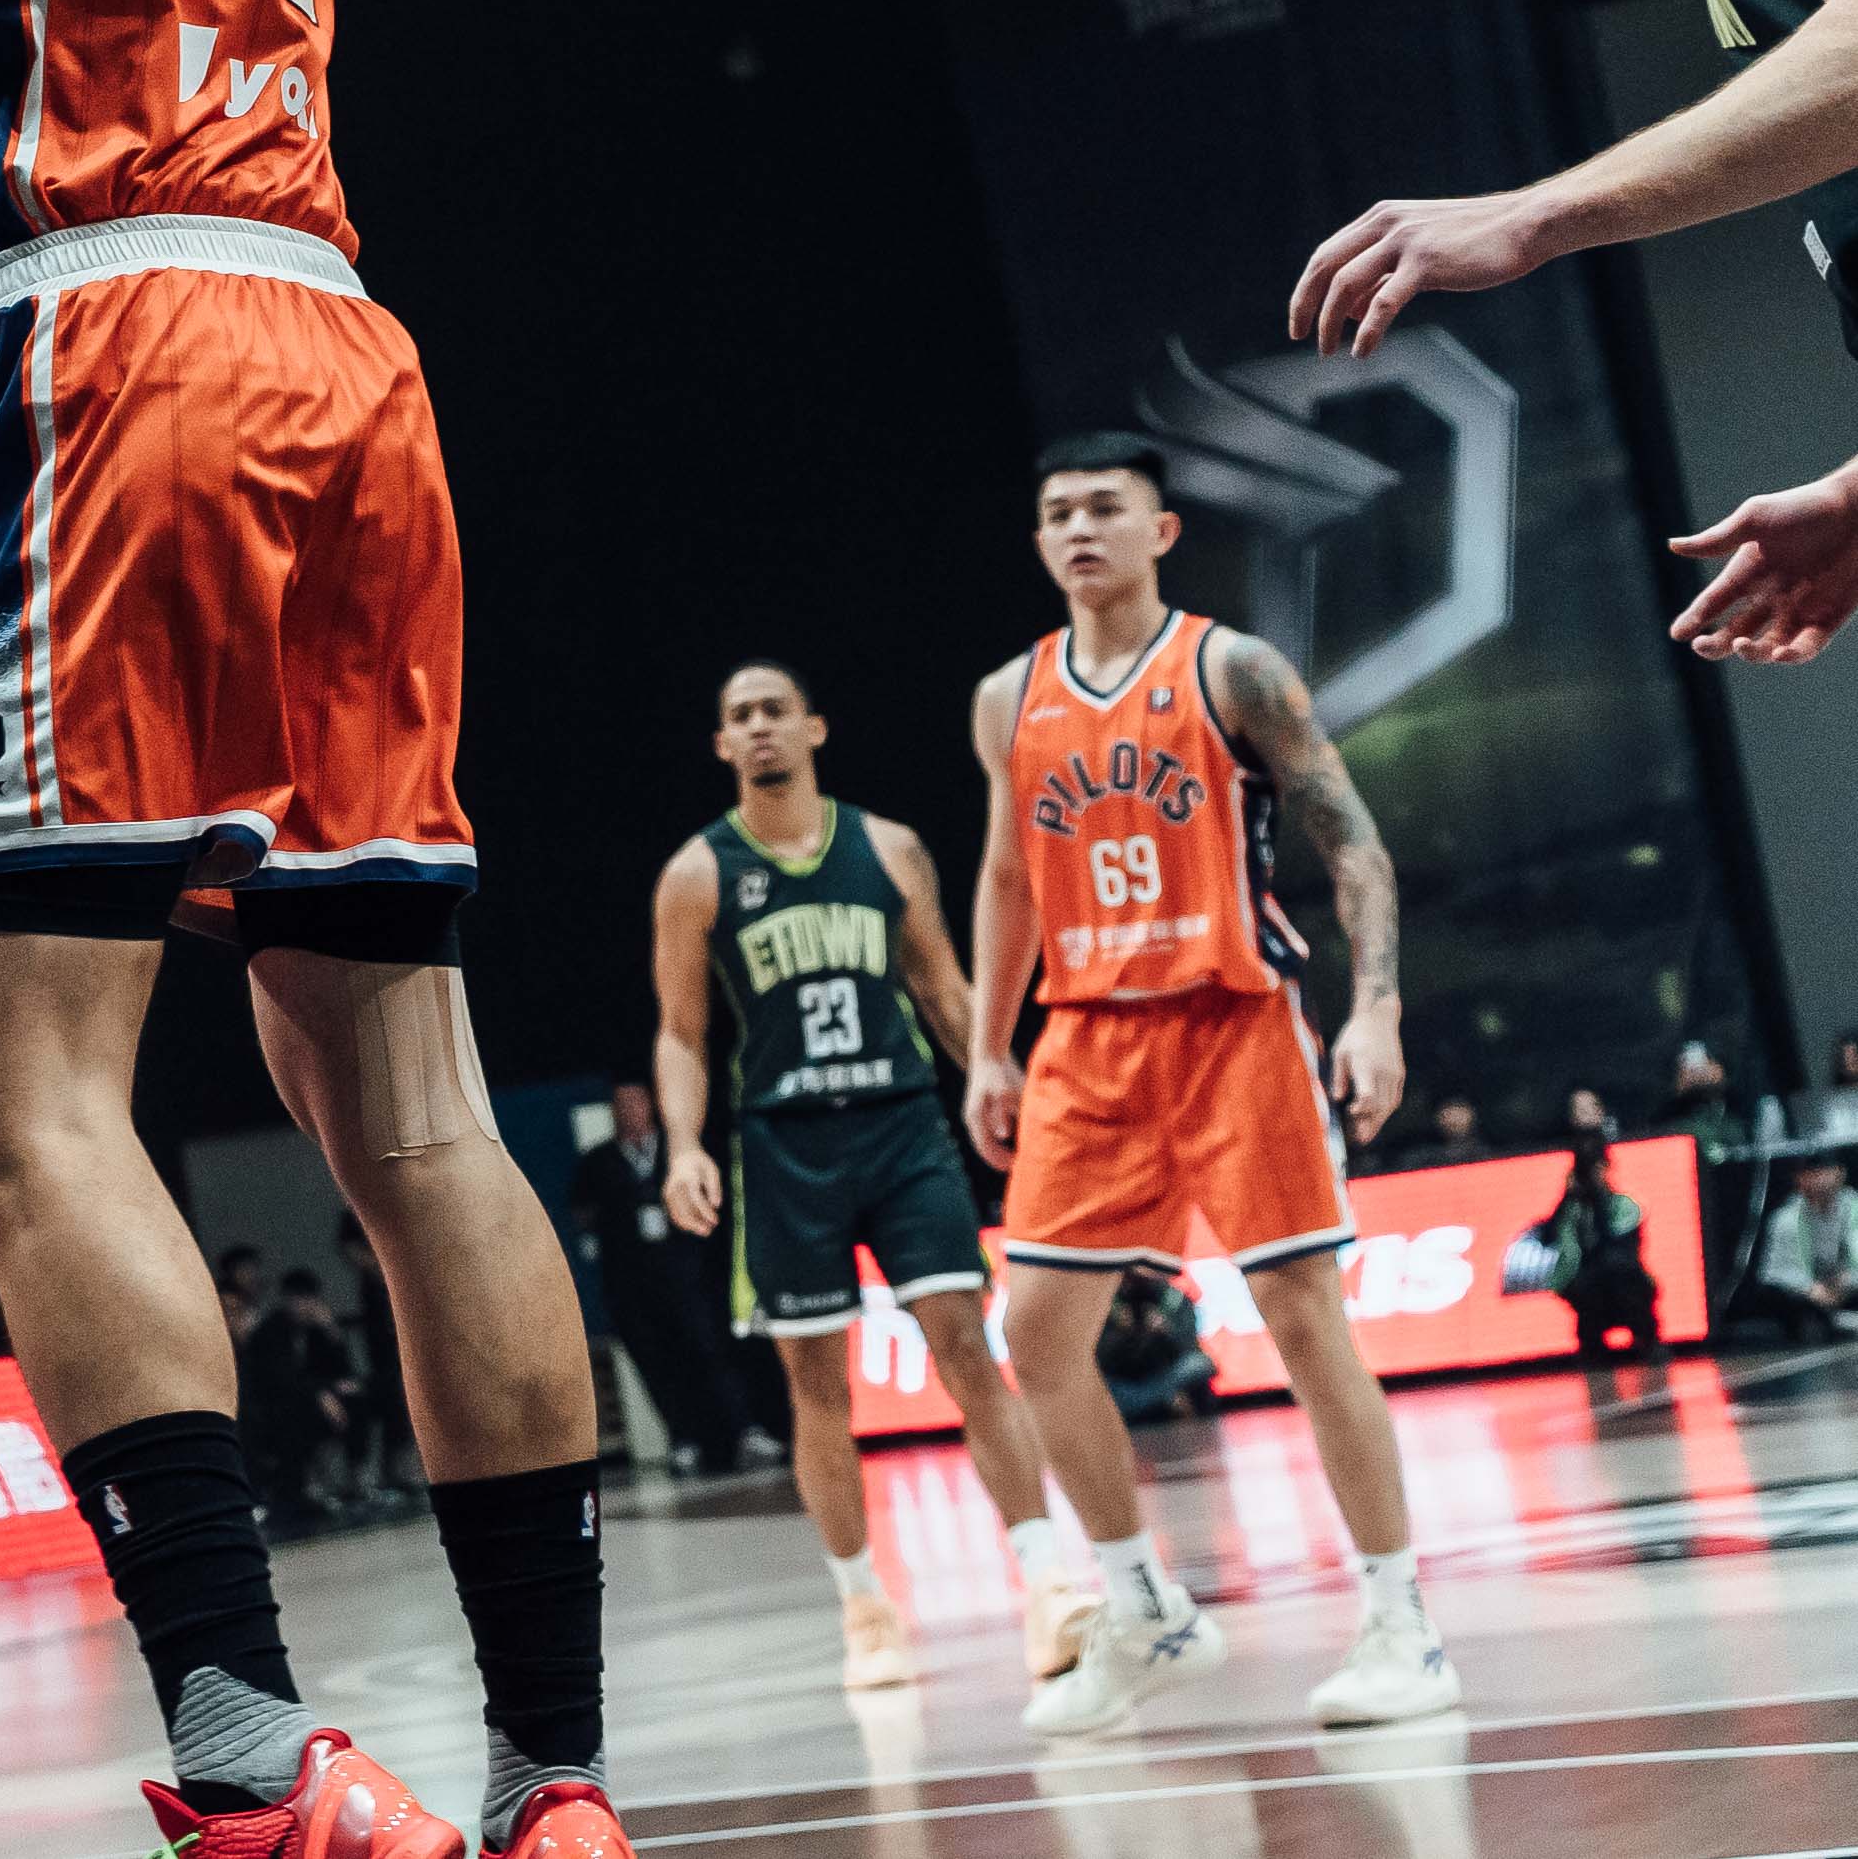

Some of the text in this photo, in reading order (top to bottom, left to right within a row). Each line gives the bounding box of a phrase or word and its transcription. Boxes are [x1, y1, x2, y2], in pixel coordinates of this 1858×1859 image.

[1035, 738, 1209, 837] PILOTS
[1089, 833, 1163, 909] 69
[797, 977, 863, 1059] 23
